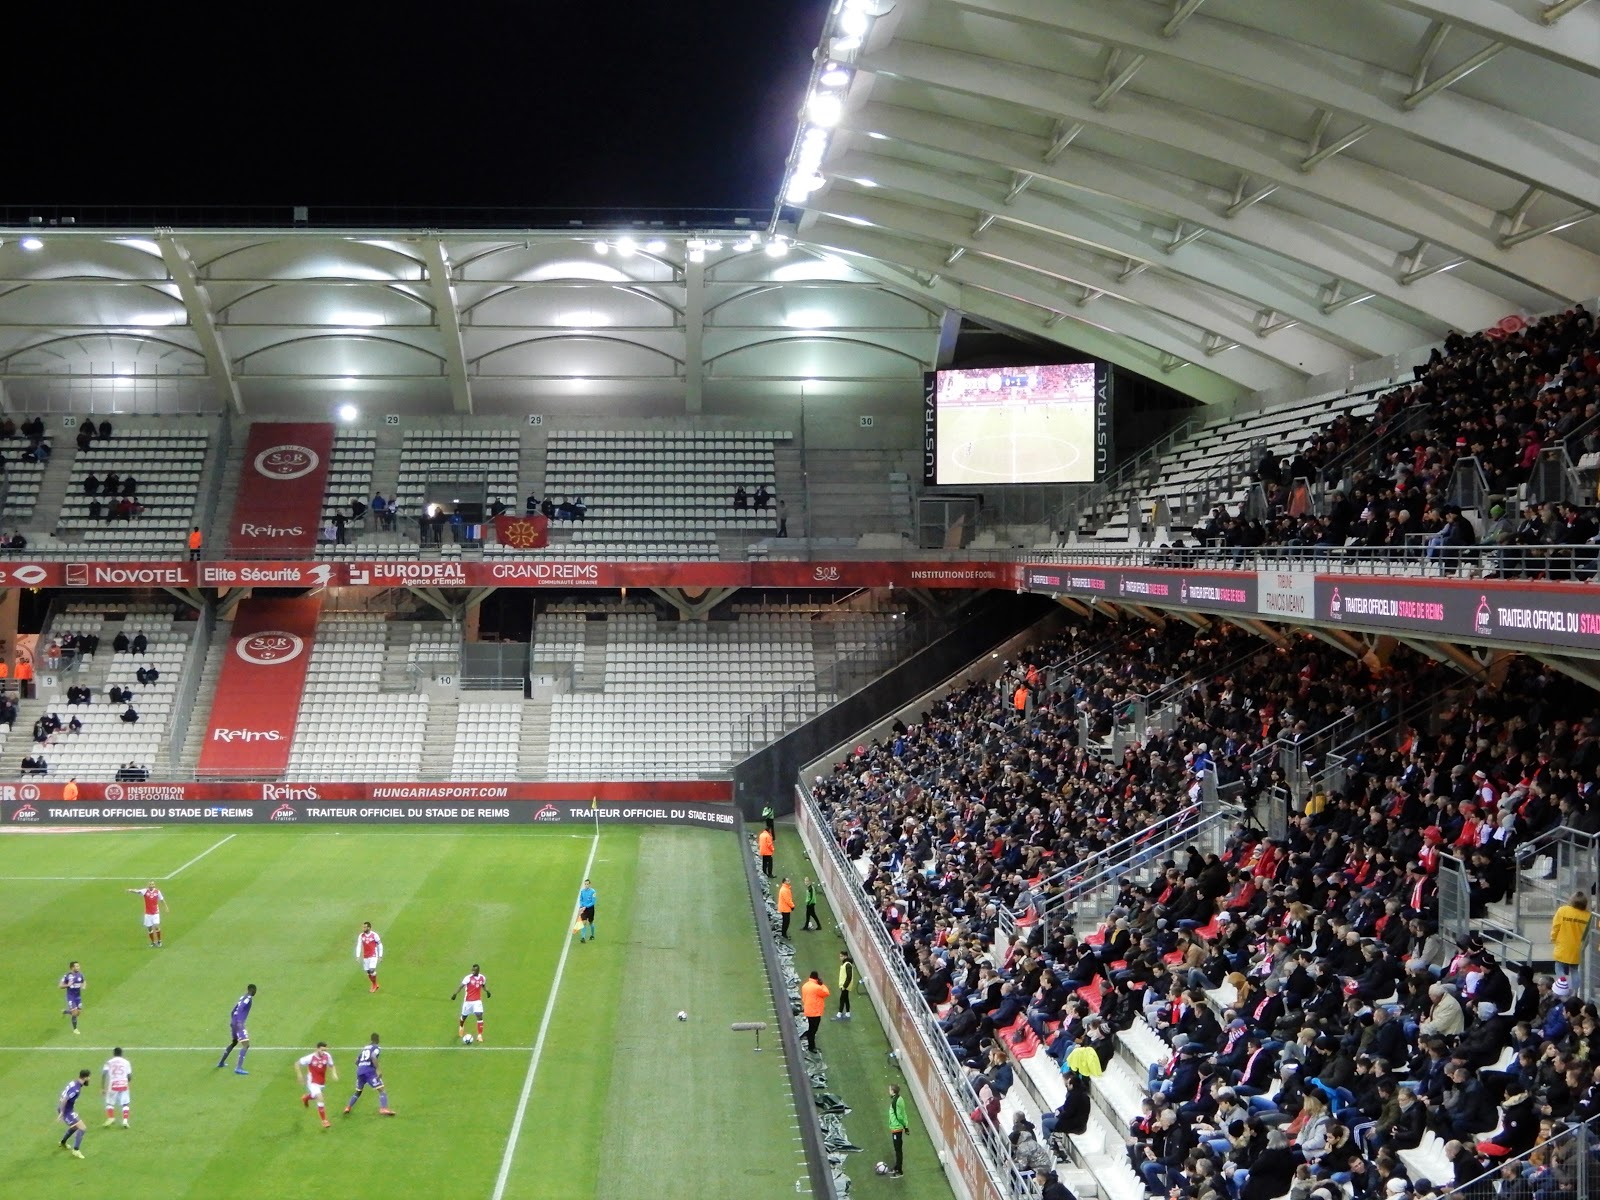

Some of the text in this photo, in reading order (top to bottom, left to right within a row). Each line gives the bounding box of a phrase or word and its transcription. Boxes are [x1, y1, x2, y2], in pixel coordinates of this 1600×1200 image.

[64, 418, 76, 426] 28
[387, 416, 398, 424] 29
[530, 416, 541, 424] 29
[861, 417, 872, 426] 30
[1098, 372, 1107, 473] LUSTRAL
[925, 380, 934, 478] LUSTRAL
[240, 523, 303, 538] Reims
[95, 567, 189, 583] NOVOTEL
[204, 567, 301, 581] Elite Sécurité
[374, 563, 466, 578] EURODEAL
[493, 564, 598, 578] GRAND REIMS
[911, 571, 964, 579] INSTITUTION
[965, 571, 974, 579] DE
[401, 577, 466, 586] Agence d'Emploi
[1345, 597, 1444, 620] TRAITEUR OFFICIEL DU STADE DE REIMS
[1498, 608, 1532, 629] TRAITEUR
[1532, 609, 1566, 632] OFFICIEL
[1567, 612, 1579, 633] DU
[46, 677, 53, 686] 9
[440, 676, 451, 684] 10
[213, 728, 280, 743] Reims
[127, 786, 185, 794] INSTITUTION
[373, 787, 508, 797] HUNGARIASPORT.COM
[127, 793, 184, 801] DE FOOTBALL
[48, 808, 254, 818] TRAITEUR OFFICIEL DU STADE DE REIMS
[306, 808, 510, 818] TRAITEUR OFFICIEL DU STADE DE REIMS
[569, 808, 734, 824] TRAITEUR OFFICIEL DU STADE DE REIMS
[360, 1049, 371, 1062] 19
[111, 1064, 124, 1076] 25
